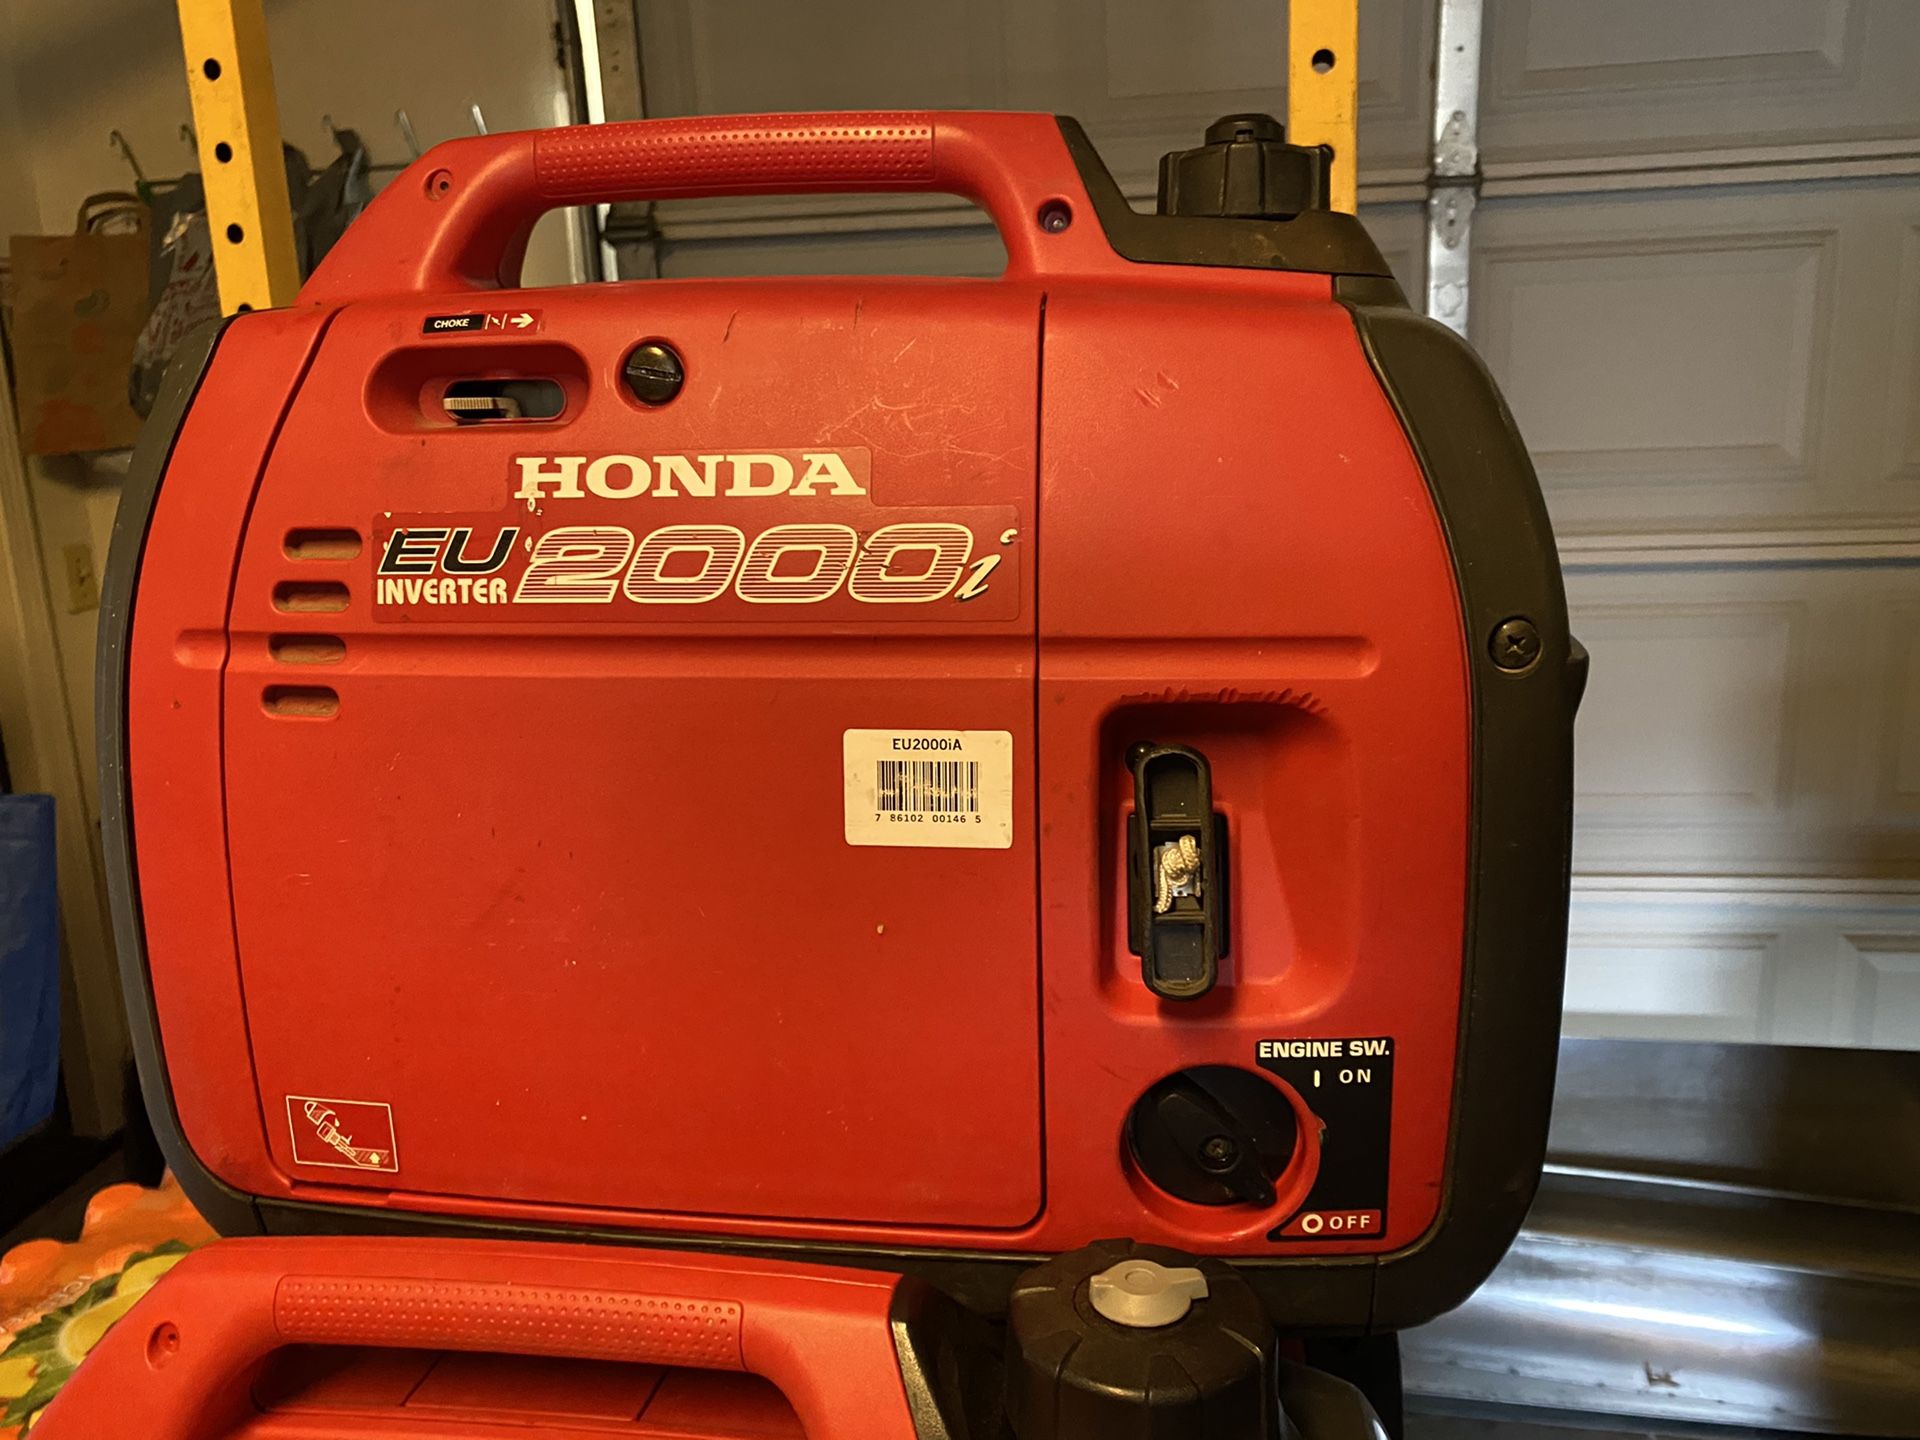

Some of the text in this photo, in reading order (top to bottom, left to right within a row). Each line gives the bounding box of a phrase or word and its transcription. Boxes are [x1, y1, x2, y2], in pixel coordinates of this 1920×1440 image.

[434, 318, 470, 328] CHOKE
[514, 453, 866, 500] HONDA
[376, 577, 508, 605] INVERTER
[892, 738, 963, 751] EU2000iA
[875, 814, 982, 824] 7 86102 00146 5
[1259, 1040, 1390, 1058] ENGINE SW.
[1339, 1069, 1371, 1084] ON
[1329, 1215, 1370, 1229] OFF
